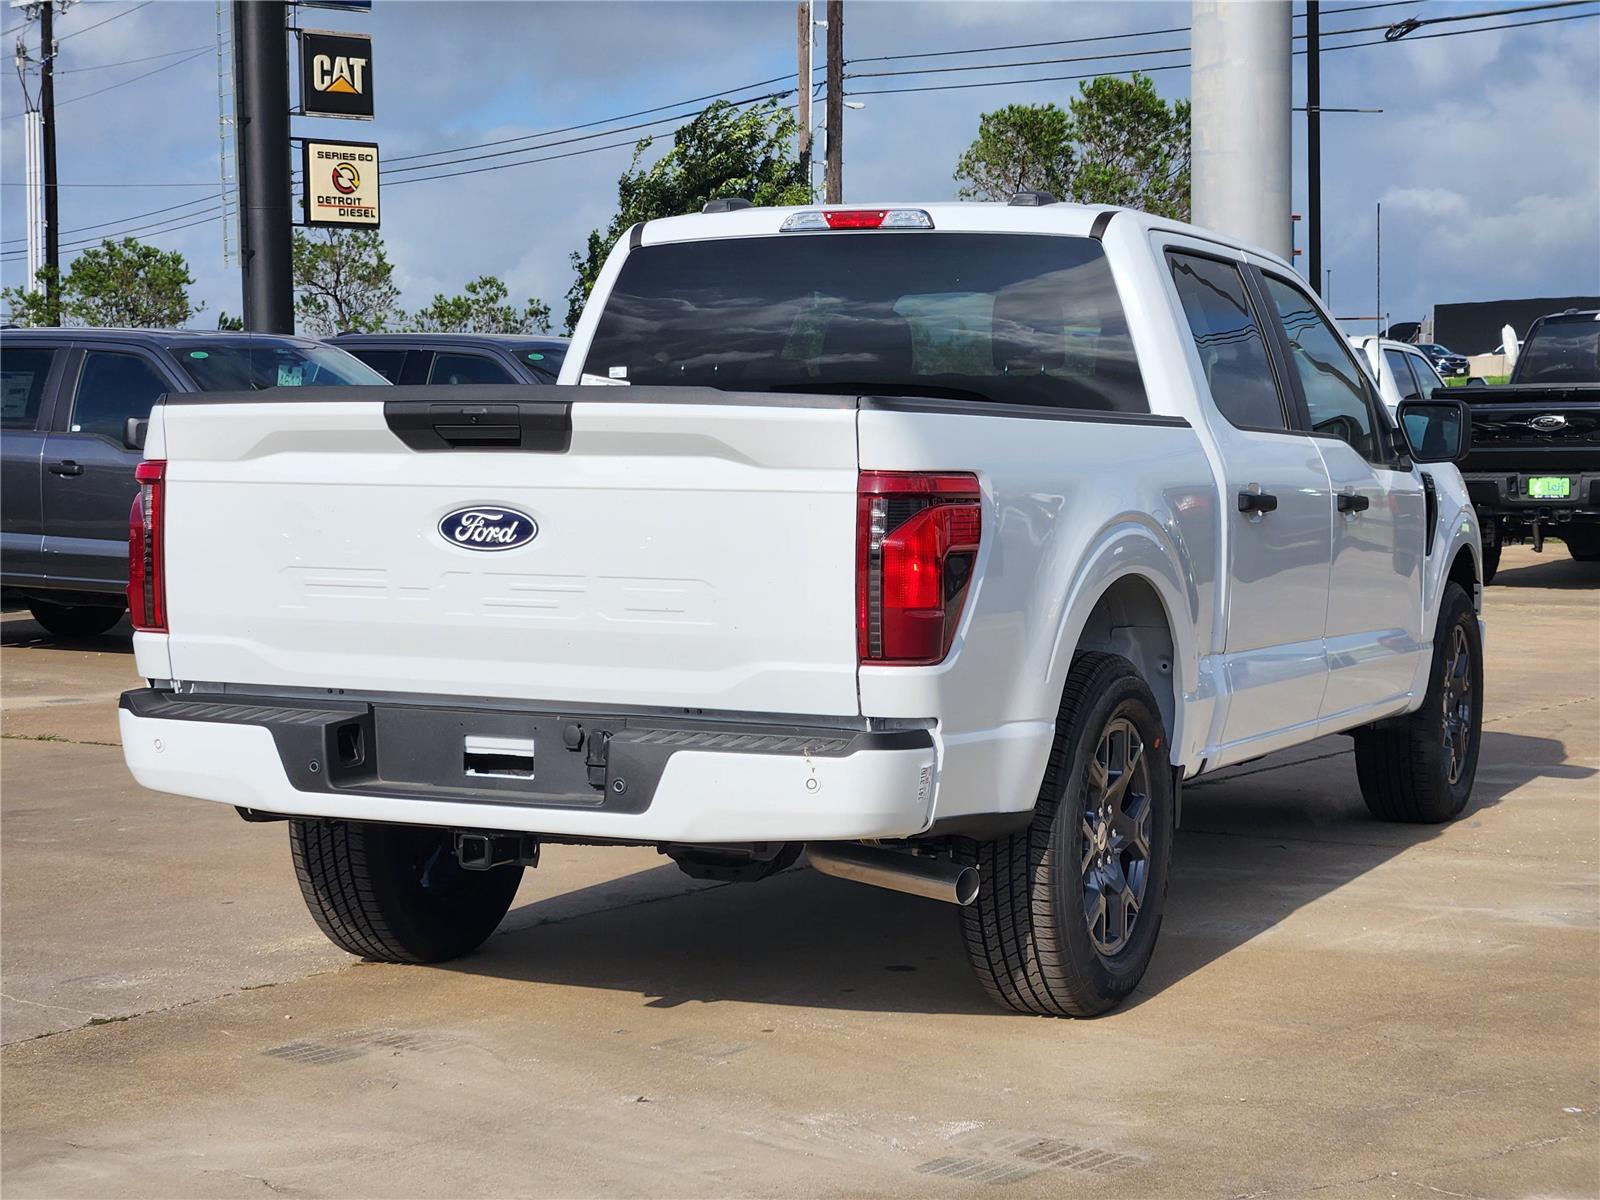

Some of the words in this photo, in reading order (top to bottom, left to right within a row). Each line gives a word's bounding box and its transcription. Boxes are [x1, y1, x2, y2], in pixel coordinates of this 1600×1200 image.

[313, 54, 368, 94] CAT
[317, 151, 357, 161] SERIES
[358, 153, 374, 162] 60
[317, 195, 362, 206] DETROIT
[338, 208, 376, 218] DIESEL
[455, 512, 519, 544] Ford
